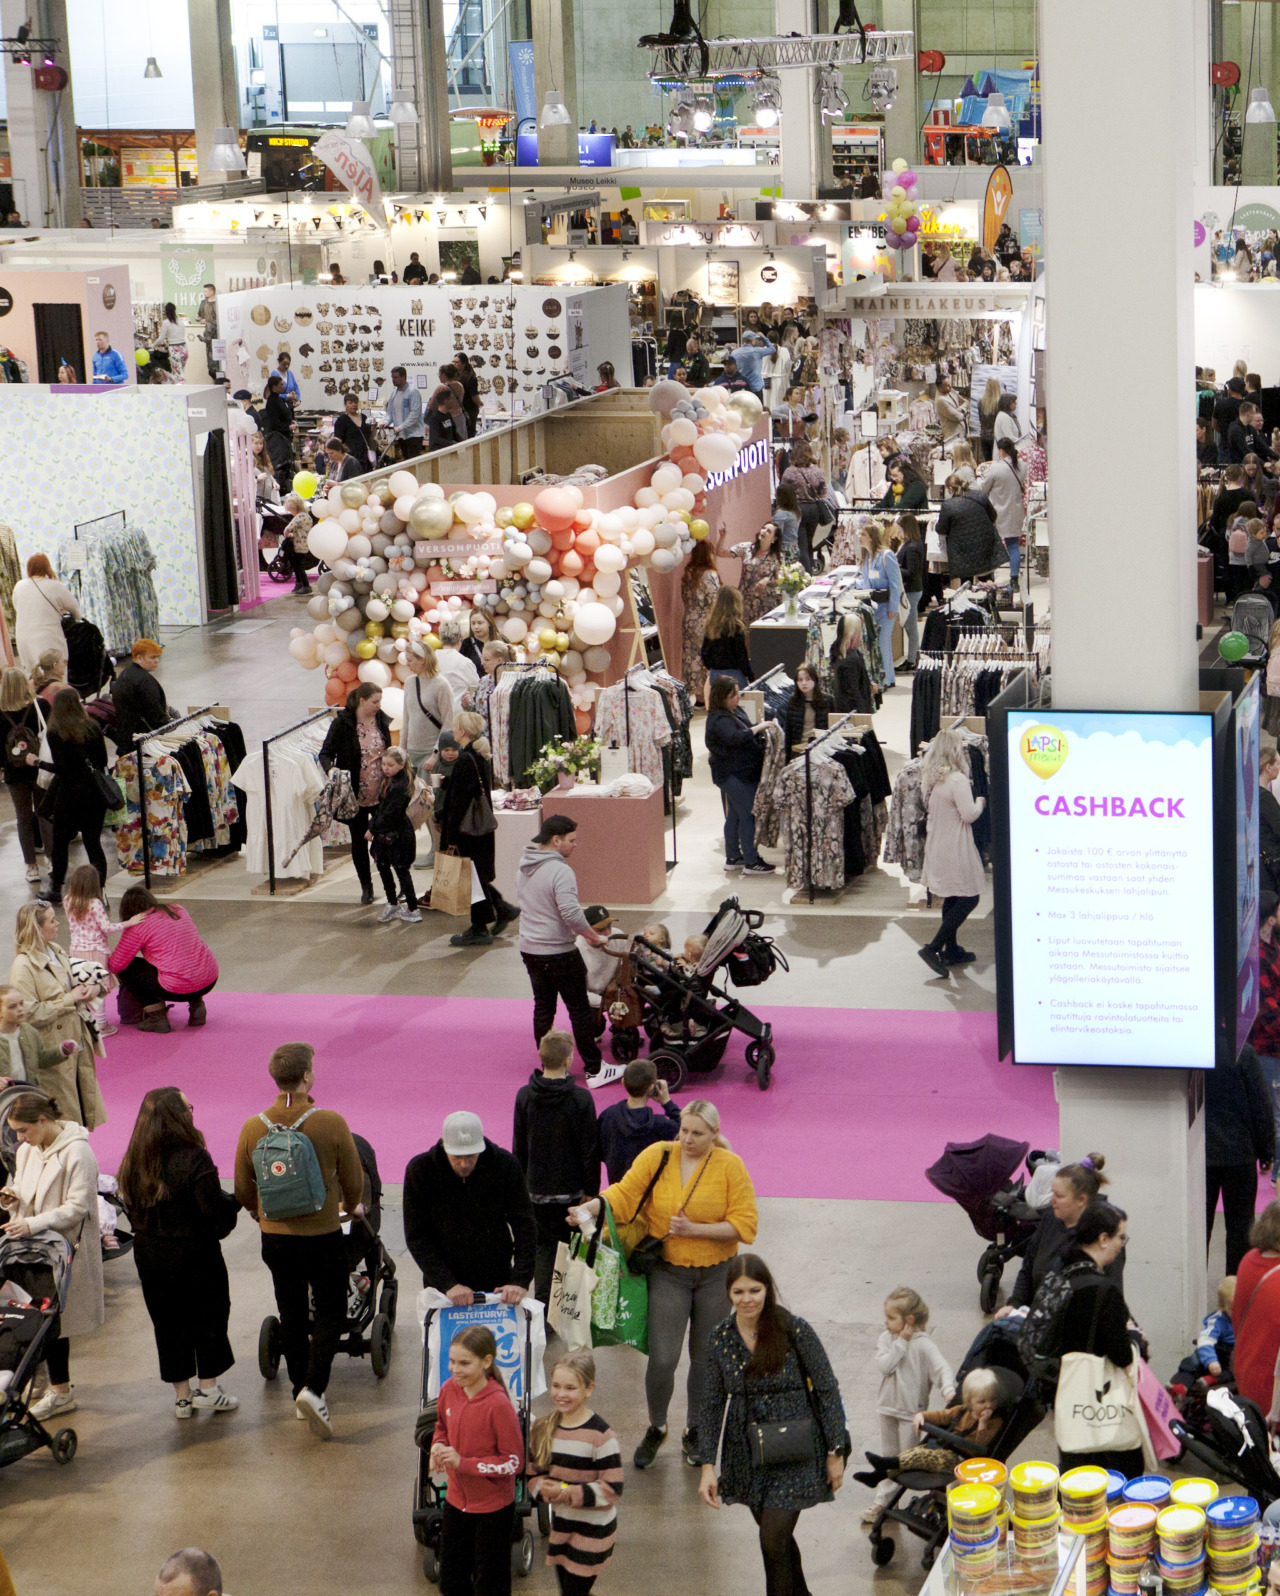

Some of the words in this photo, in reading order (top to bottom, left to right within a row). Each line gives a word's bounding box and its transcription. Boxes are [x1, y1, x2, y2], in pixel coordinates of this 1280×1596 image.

[569, 177, 594, 185] Museo
[596, 177, 617, 185] Leikki
[853, 298, 986, 311] MAINELAKEUS
[1034, 794, 1186, 819] CASHBACK
[1046, 846, 1083, 856] Jokaista
[1086, 847, 1104, 856] 100
[1106, 847, 1113, 856] €
[1115, 849, 1142, 857] arvon
[1047, 860, 1079, 869] ostosta
[1081, 861, 1093, 869] tai
[1095, 861, 1133, 870] ostosten
[1135, 862, 1180, 871] kokonais-
[1047, 874, 1086, 882] summaa
[1088, 874, 1124, 882] vastaan
[1126, 875, 1145, 883] saat
[1147, 875, 1175, 885] yhden
[1047, 885, 1121, 895] Messukeskuksen
[1123, 886, 1171, 897] lahjalipun.
[1047, 910, 1067, 920] Max
[1069, 911, 1076, 919] 3
[1078, 910, 1130, 922] lahjalippua
[1139, 912, 1154, 921] hlö
[1048, 936, 1070, 946] Liput
[1072, 936, 1125, 946] luovutetaan
[1127, 938, 1182, 949] tapahtuman
[1048, 949, 1080, 958] aikana
[1082, 950, 1159, 960] Messutoimistossa
[1161, 951, 1190, 961] kuittia
[1048, 962, 1087, 971] vastaan.
[1089, 962, 1153, 973] Messutoimisto
[1154, 964, 1191, 974] sijaitsee
[1049, 999, 1094, 1009] Cashback
[1095, 1000, 1105, 1009] ei
[1107, 1000, 1133, 1010] koske
[1135, 1002, 1199, 1012] tapahtumassa
[1049, 1012, 1092, 1023] nautittuja
[1094, 1013, 1170, 1024] ravintolatuotteita
[1172, 1015, 1184, 1024] tai
[1049, 1024, 1134, 1036] elintarvikeostoksia.
